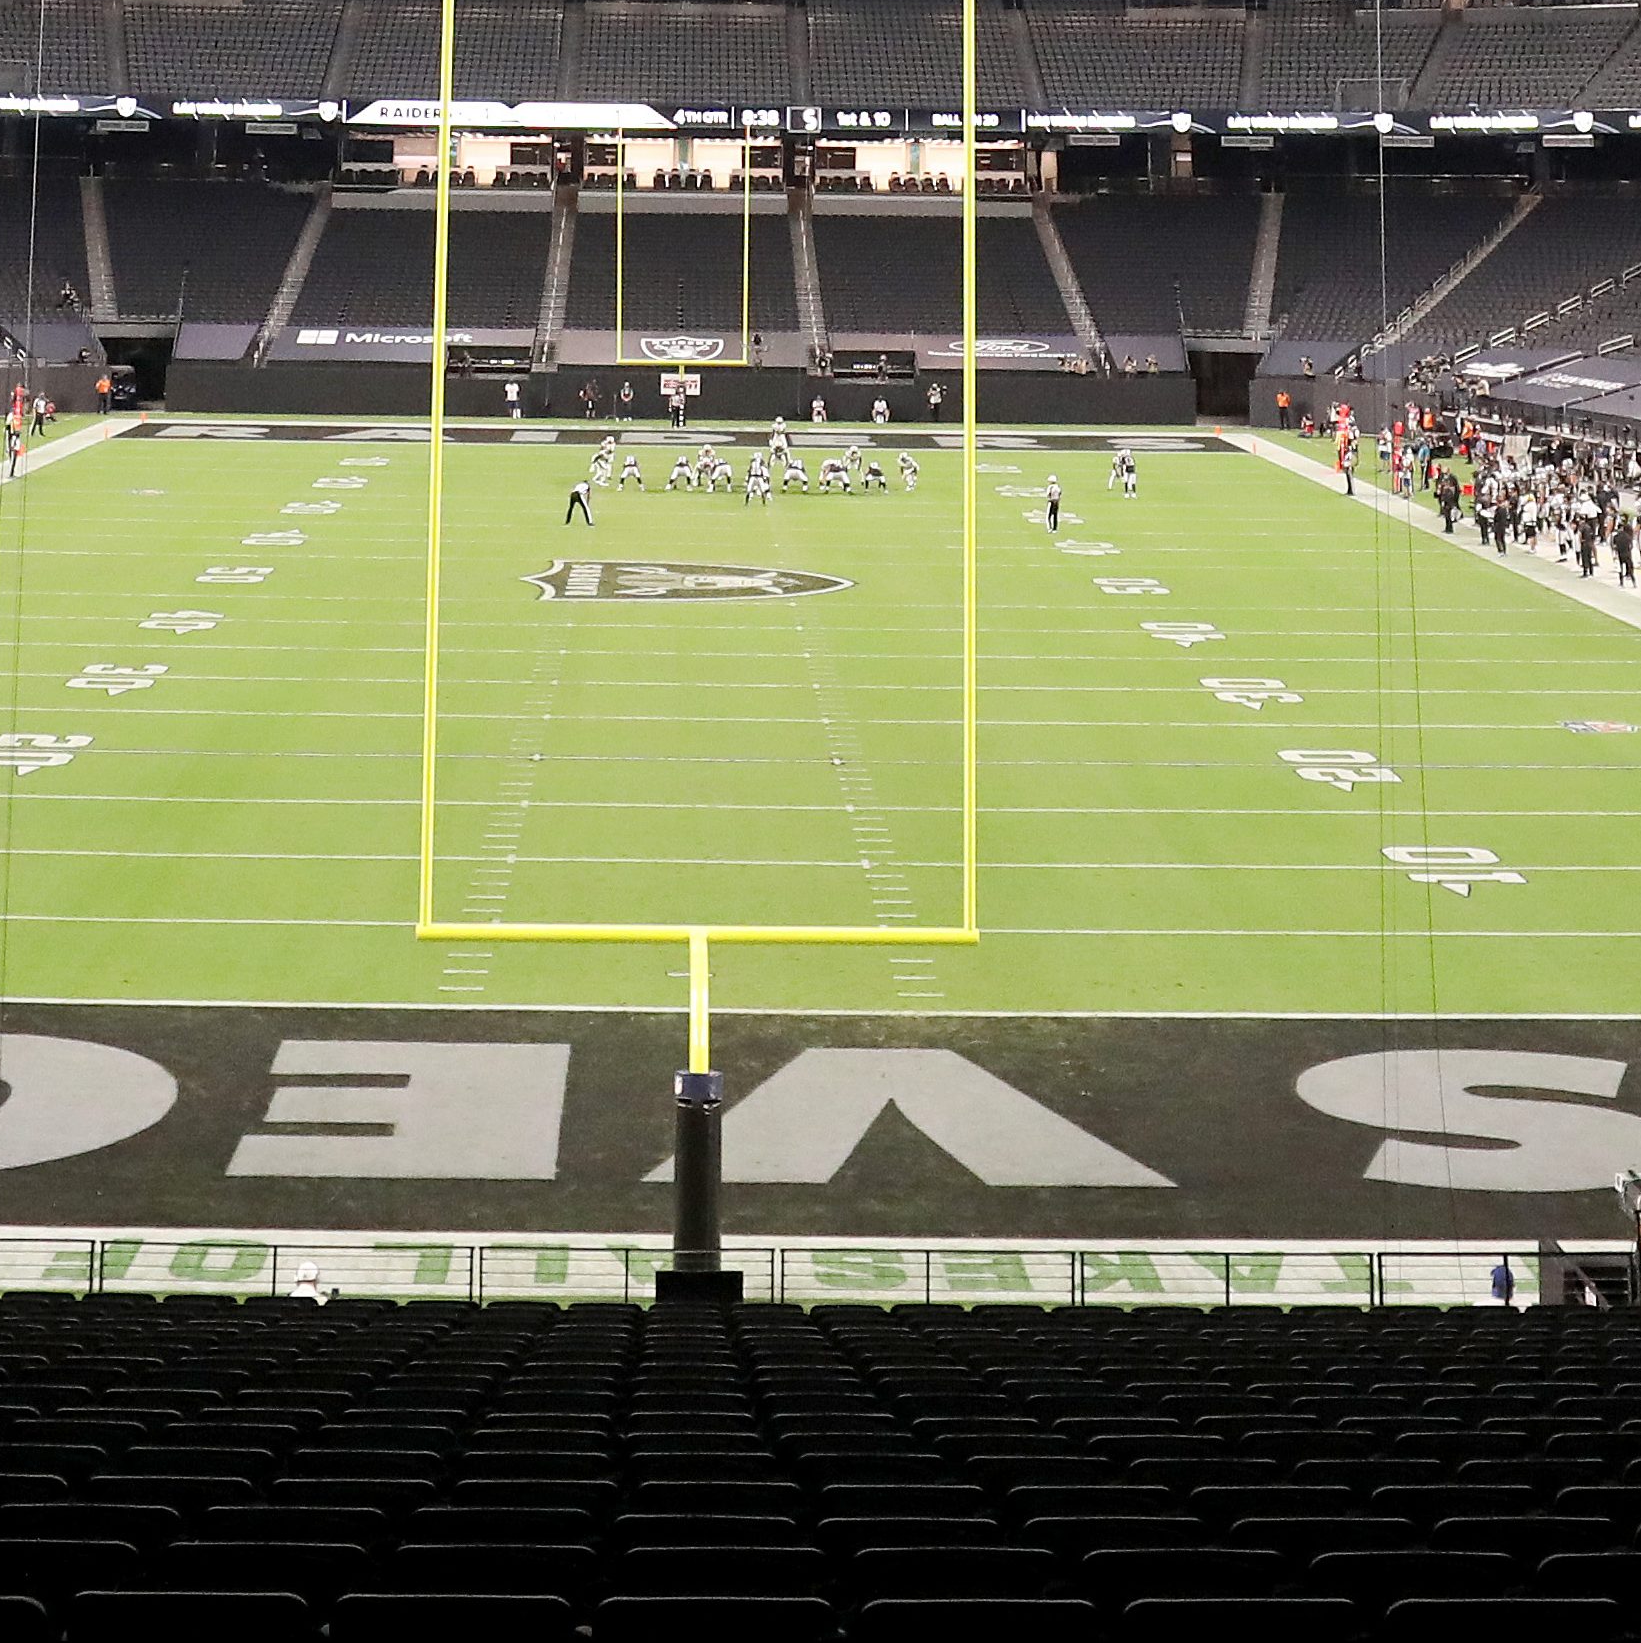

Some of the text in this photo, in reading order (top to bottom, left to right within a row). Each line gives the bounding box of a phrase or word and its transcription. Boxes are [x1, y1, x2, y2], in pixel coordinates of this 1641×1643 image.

[65, 664, 170, 689] 30
[1198, 677, 1305, 703] 30
[1276, 749, 1404, 783] 20
[1381, 845, 1529, 884] 10
